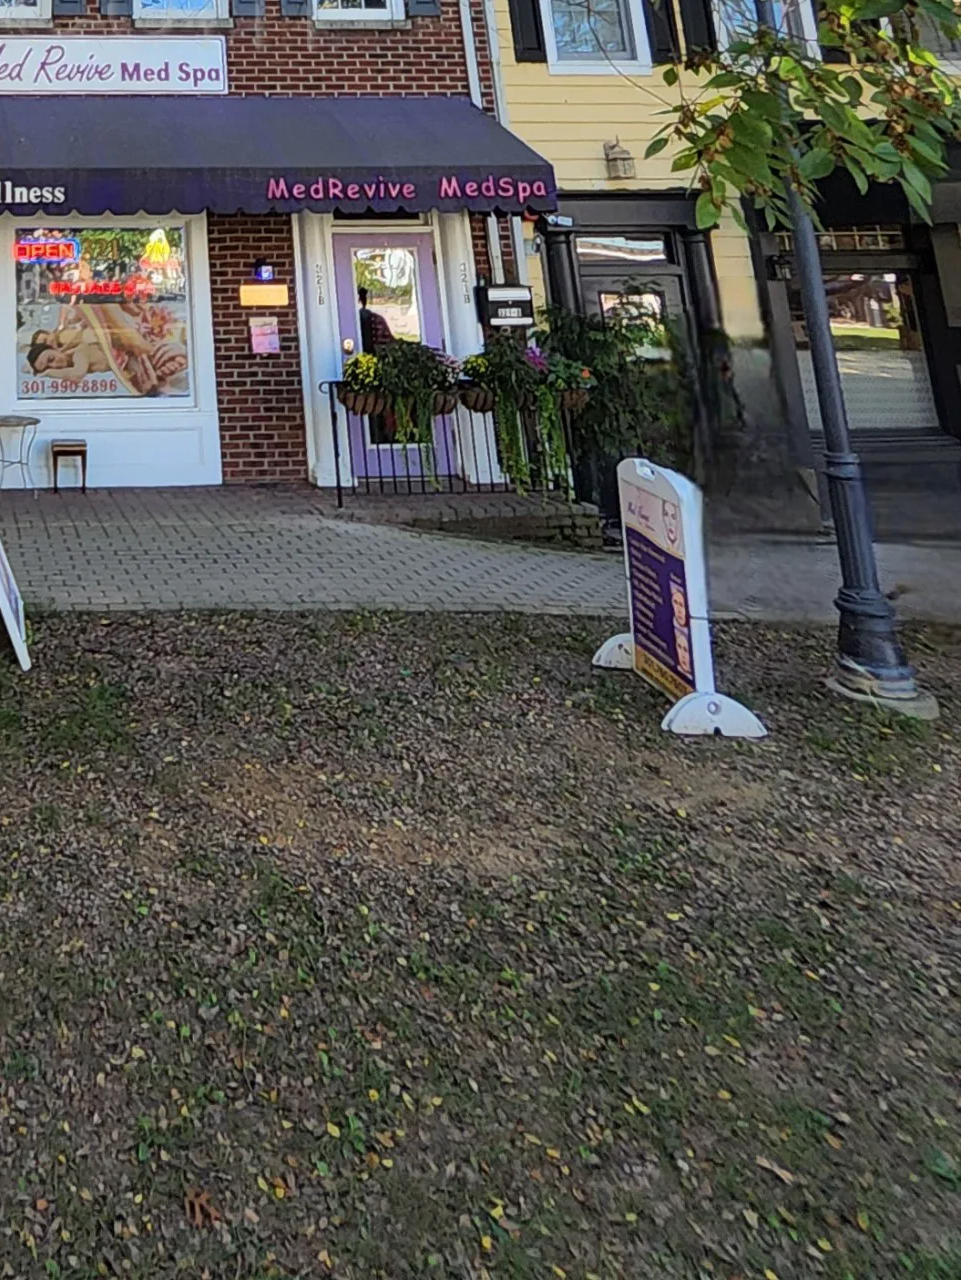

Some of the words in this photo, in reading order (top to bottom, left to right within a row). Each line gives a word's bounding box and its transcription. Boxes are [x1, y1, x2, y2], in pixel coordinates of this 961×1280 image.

[33, 45, 116, 84] Revive
[121, 62, 170, 81] Med
[177, 62, 220, 87] Spa
[267, 176, 416, 200] MedRevive
[440, 176, 546, 203] MedSpa
[13, 241, 75, 260] OPEN
[21, 378, 118, 395] 301-990-8896
